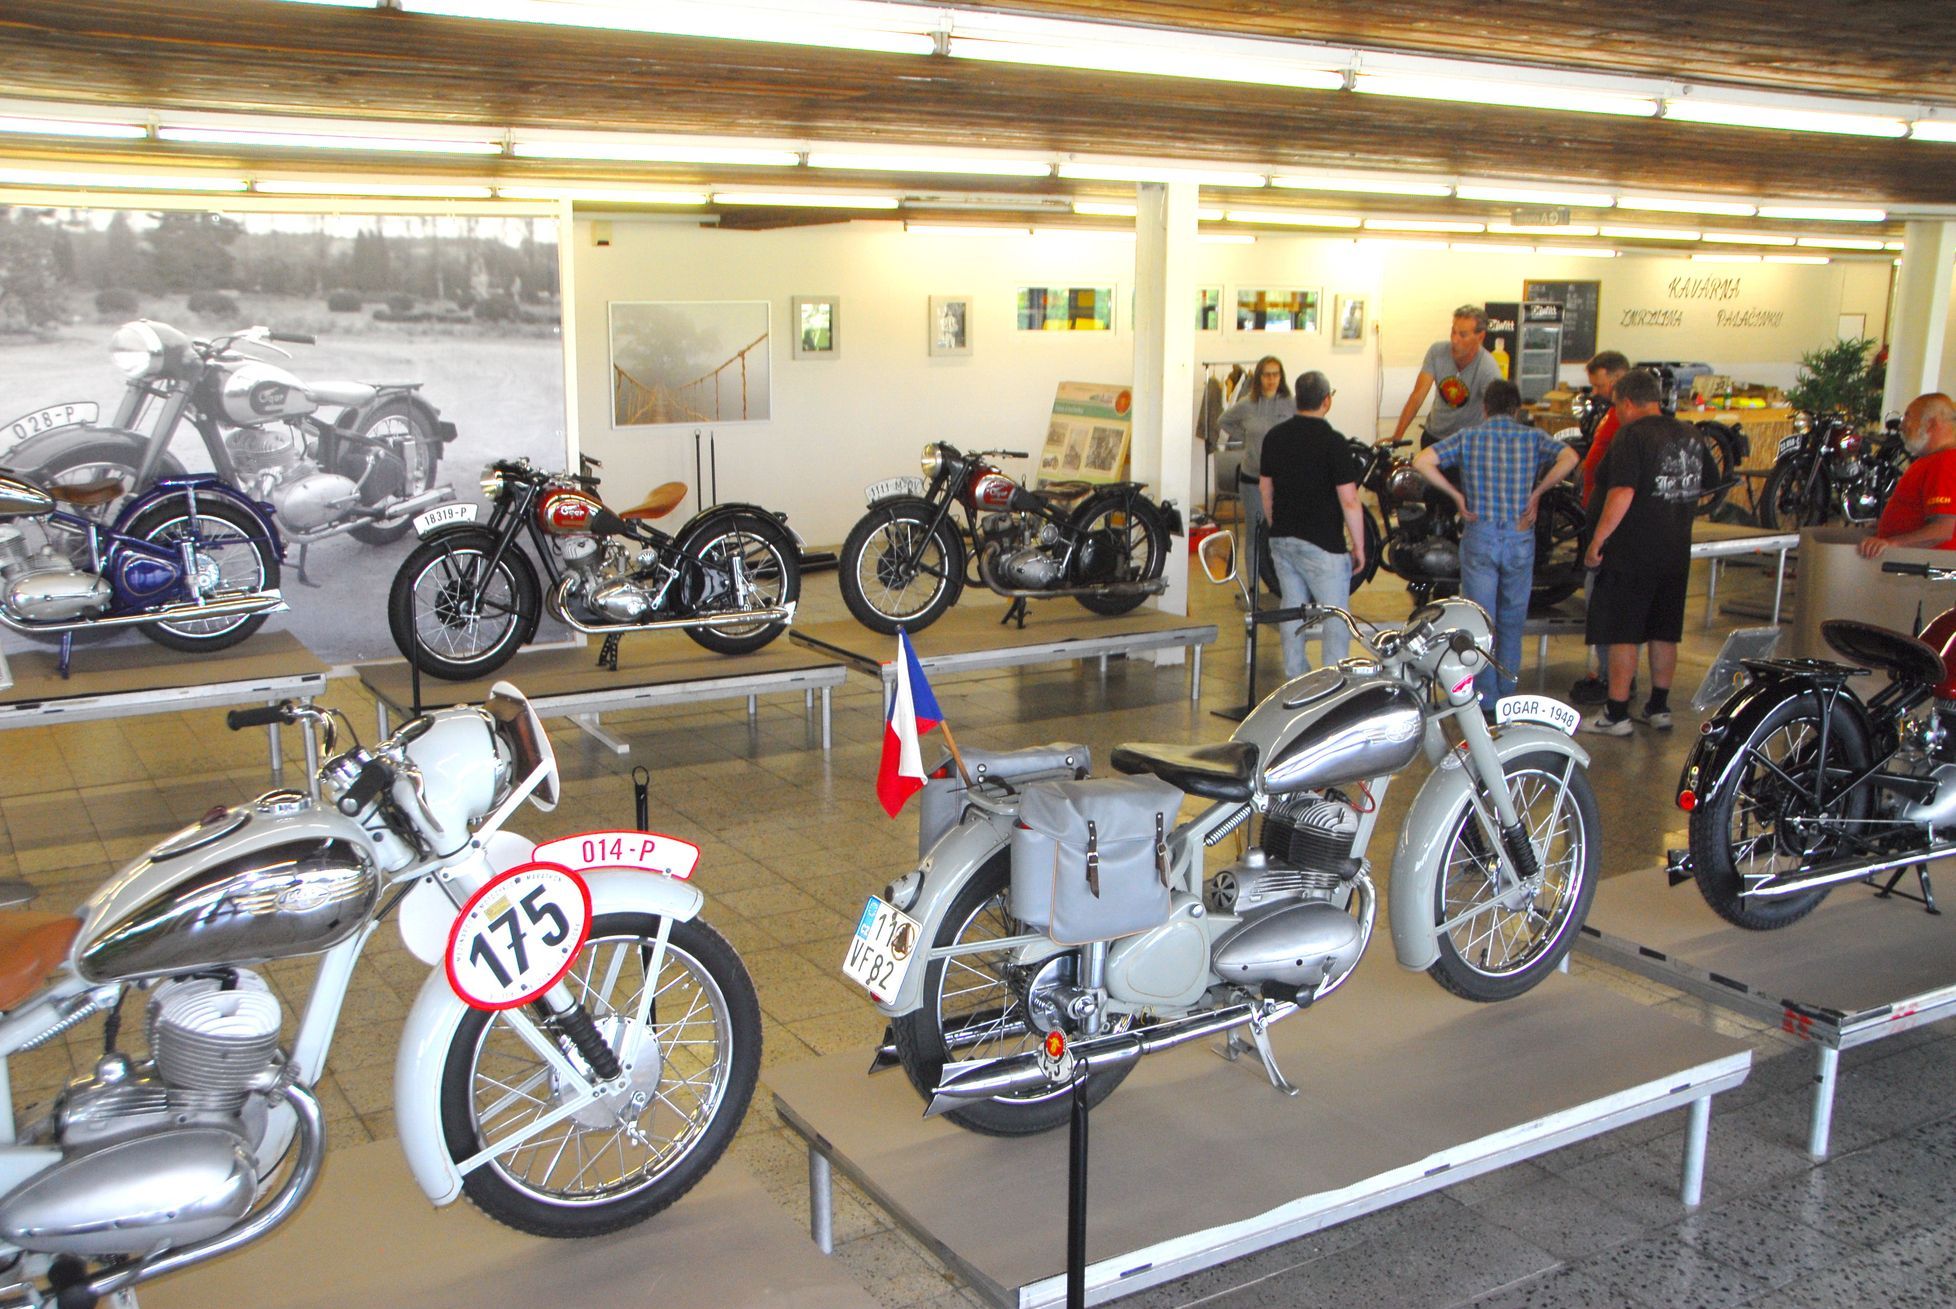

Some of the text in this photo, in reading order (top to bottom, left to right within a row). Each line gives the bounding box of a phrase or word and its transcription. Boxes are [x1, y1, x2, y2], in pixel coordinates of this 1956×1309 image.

[1669, 274, 1741, 300] KAVÁRNA
[424, 508, 467, 526] 18319-P
[1502, 701, 1539, 716] OGAR
[1550, 706, 1574, 727] 1948
[582, 838, 655, 863] 014-P
[469, 883, 570, 989] 175
[850, 939, 894, 990] VF82
